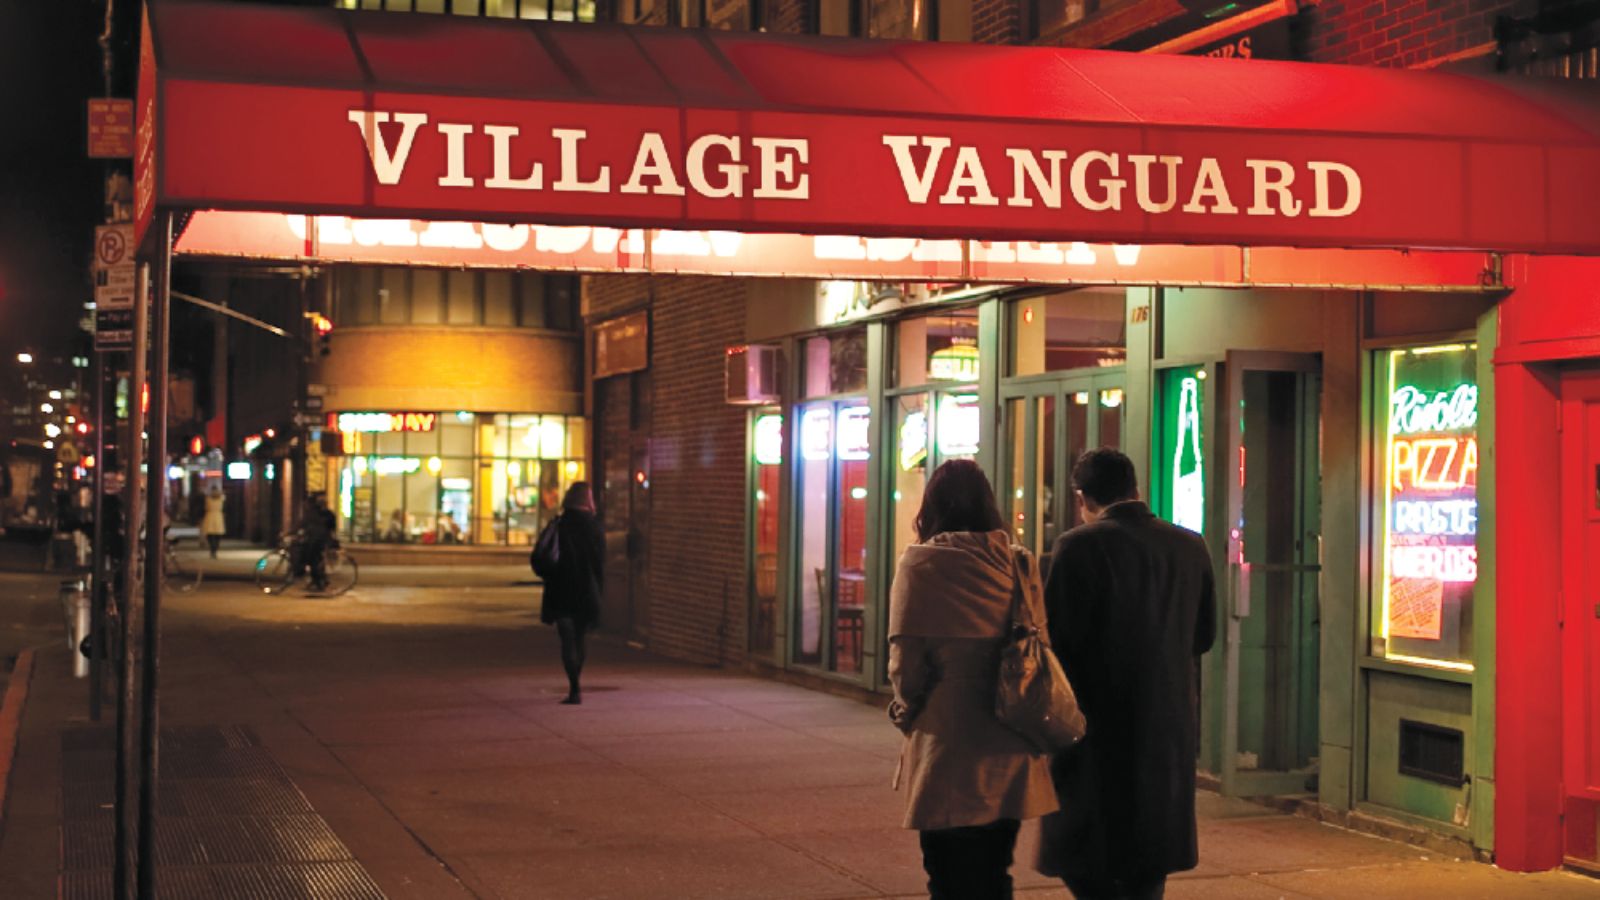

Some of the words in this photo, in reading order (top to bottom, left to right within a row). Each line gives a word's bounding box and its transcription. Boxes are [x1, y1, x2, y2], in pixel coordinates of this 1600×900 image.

[348, 110, 809, 199] VILLAGE
[883, 135, 1362, 217] VANGUARD
[1131, 305, 1150, 324] 176
[1394, 438, 1477, 492] PIZZA
